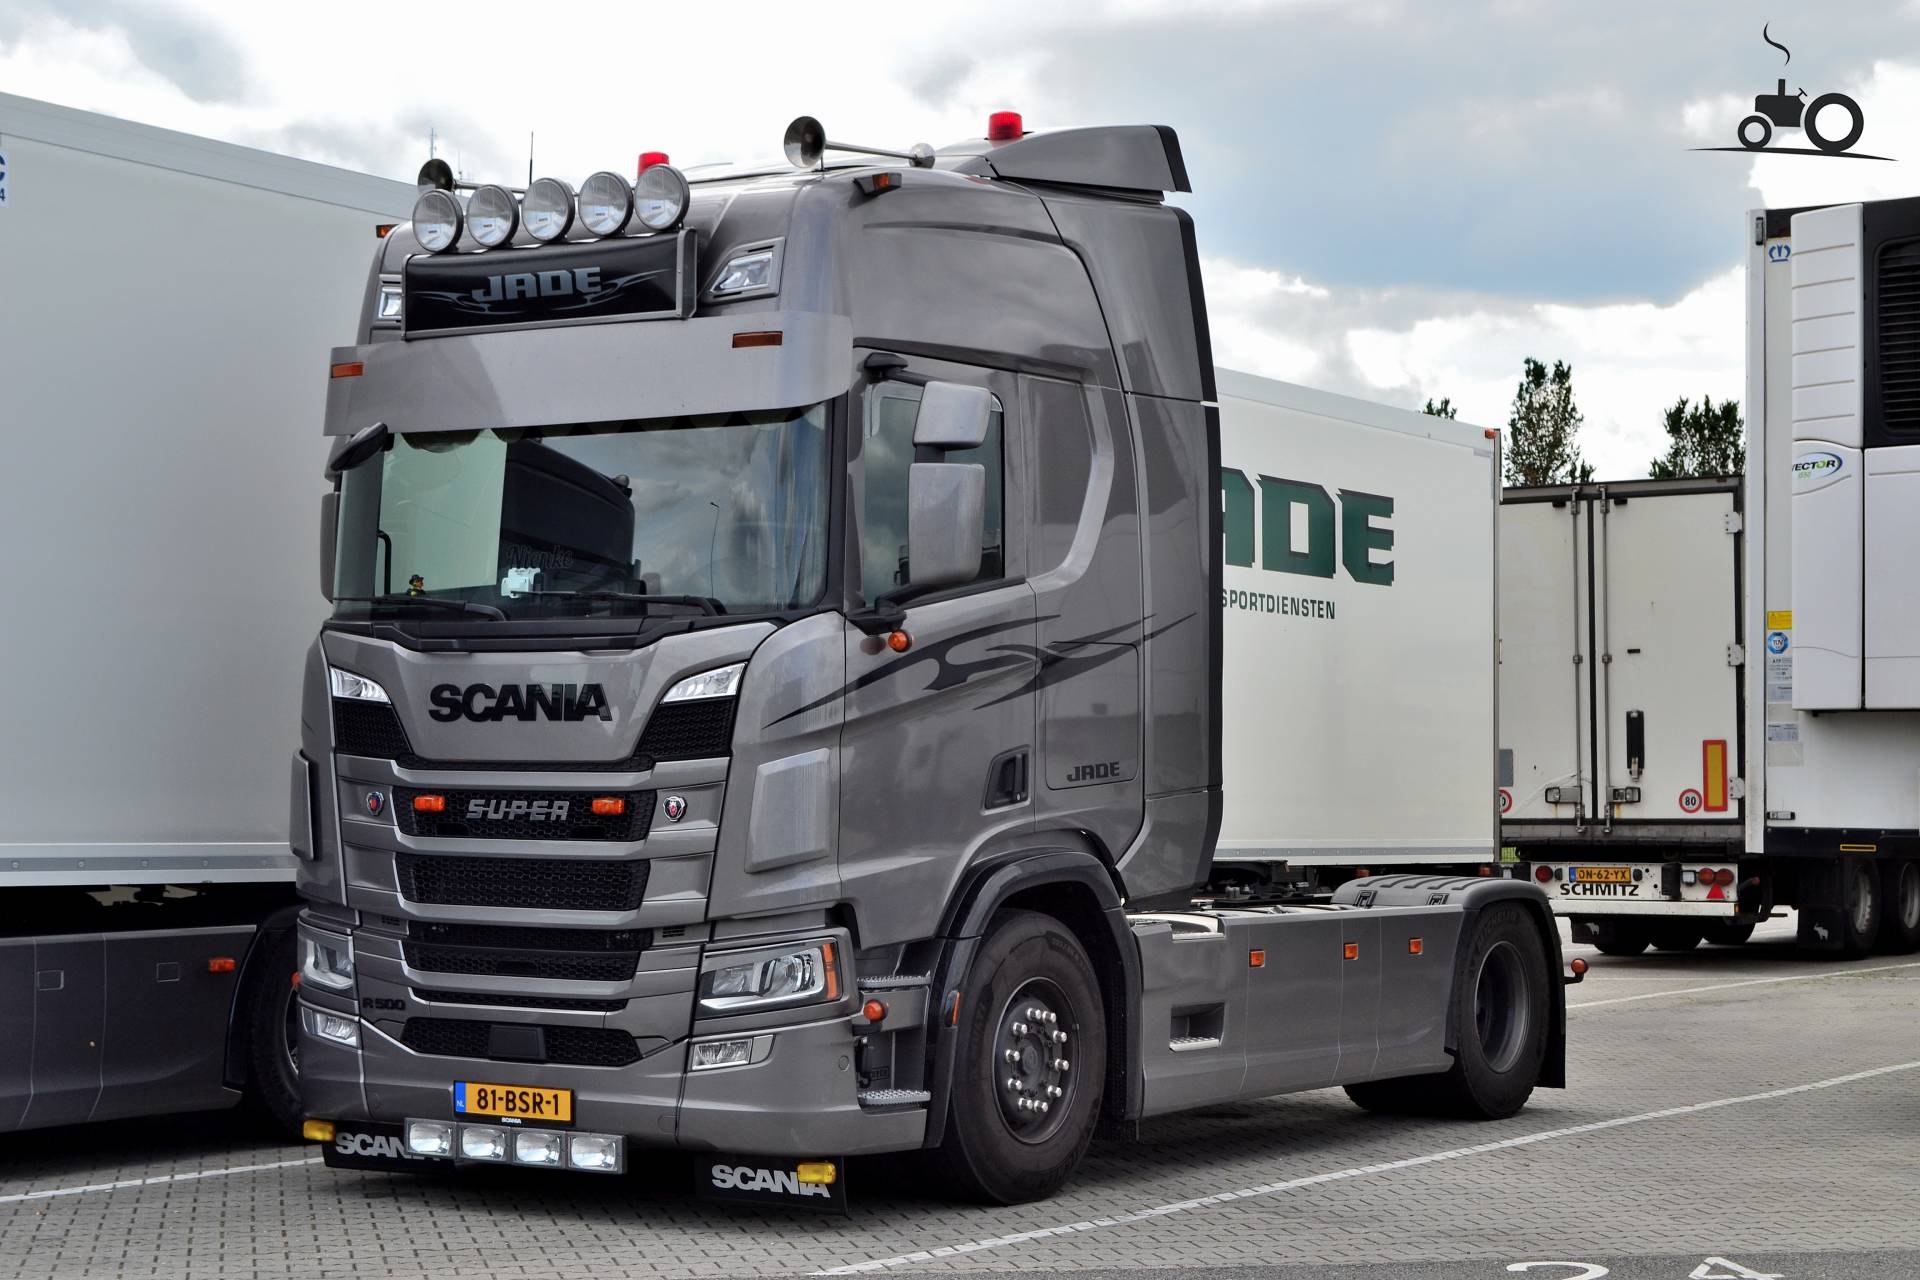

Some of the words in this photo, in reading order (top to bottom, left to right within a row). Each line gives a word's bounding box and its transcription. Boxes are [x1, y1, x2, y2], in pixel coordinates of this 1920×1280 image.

[471, 267, 601, 300] JADE
[428, 683, 613, 722] SCANIA
[1067, 761, 1120, 782] JADE
[466, 799, 570, 821] SUPER
[1685, 796, 1697, 806] 80
[1559, 883, 1640, 896] SCHMITZ
[477, 1088, 559, 1116] 81-BSR-1
[335, 1132, 440, 1161] SCAN
